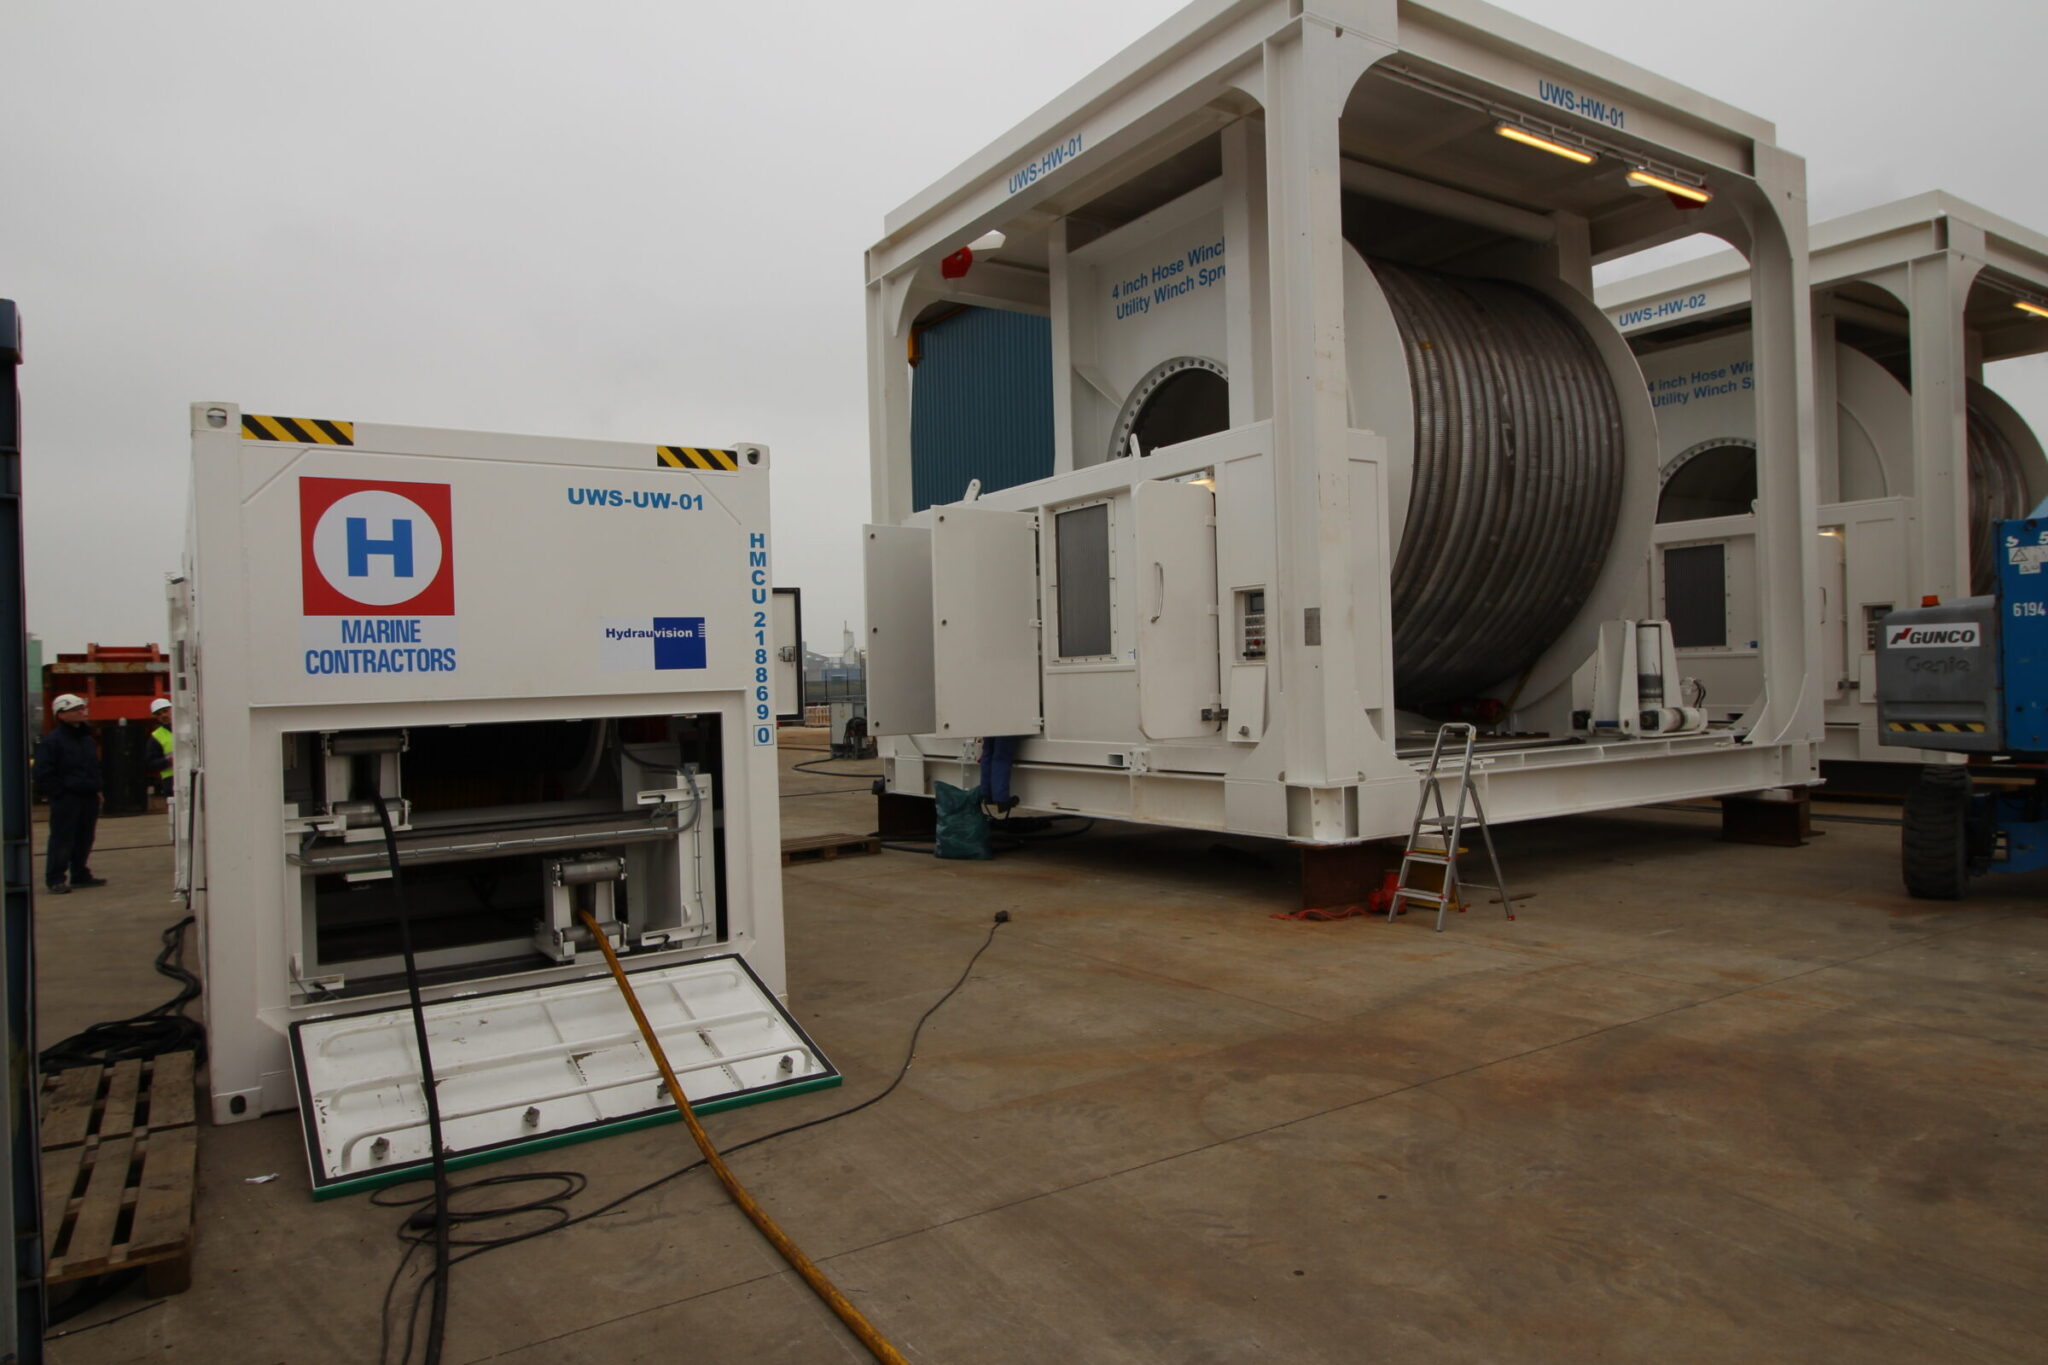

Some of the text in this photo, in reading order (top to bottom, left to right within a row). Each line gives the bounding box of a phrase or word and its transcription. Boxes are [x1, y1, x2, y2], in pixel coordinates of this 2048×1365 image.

[1539, 79, 1624, 130] UWS-HW-01
[1008, 132, 1083, 194] UWS-HW-01
[1111, 284, 1120, 300] 4
[1122, 273, 1149, 296] inch
[1151, 259, 1184, 284] Hose
[1116, 295, 1151, 320] Utility
[1153, 275, 1195, 305] Winch
[1618, 293, 1707, 327] UWS-HW-02
[1652, 391, 1690, 408] Utility
[1693, 379, 1737, 400] Winch
[1659, 375, 1687, 391] inch
[1691, 367, 1726, 385] Hose
[567, 487, 704, 511] UWS-UW-01
[346, 516, 414, 578] H
[749, 532, 767, 605] HMCU
[2012, 601, 2047, 617] 6194
[341, 619, 423, 644] MARINE
[605, 627, 693, 641] Hydrauvision
[1909, 629, 1976, 645] GUNCO
[305, 647, 457, 675] CONTRACTORS
[753, 611, 770, 721] 218869
